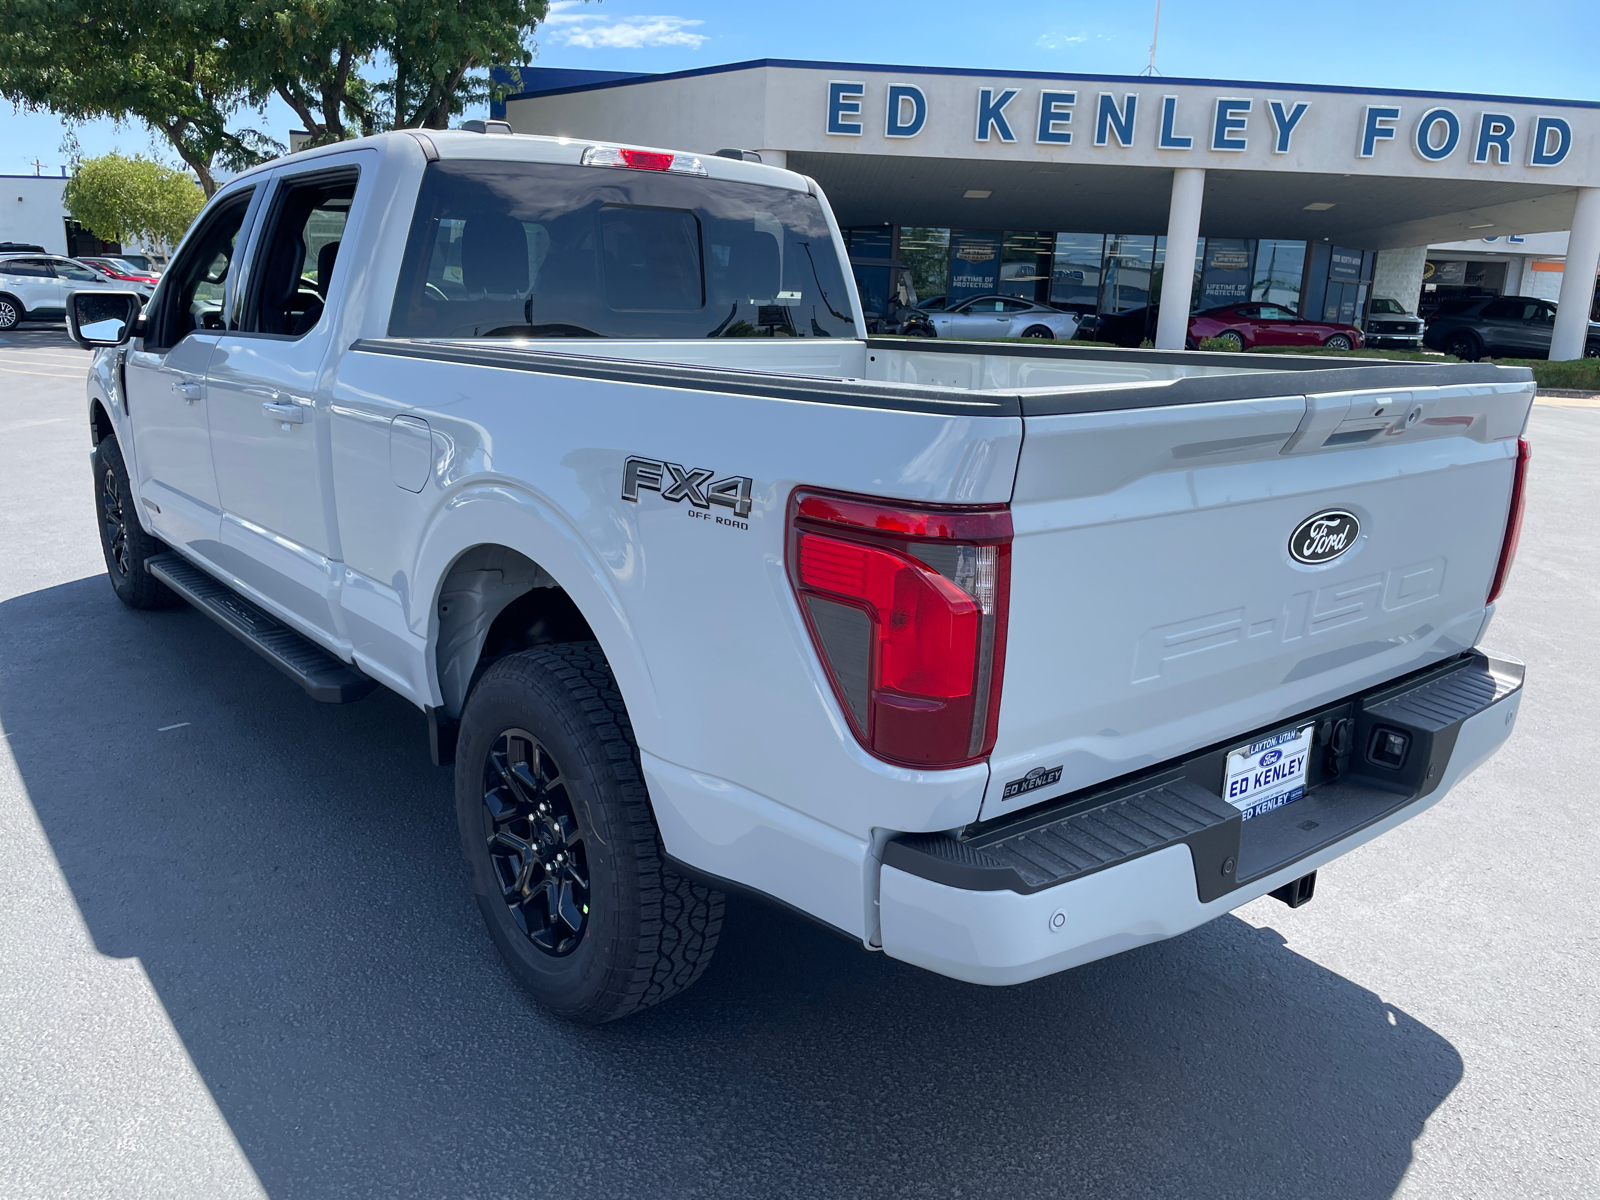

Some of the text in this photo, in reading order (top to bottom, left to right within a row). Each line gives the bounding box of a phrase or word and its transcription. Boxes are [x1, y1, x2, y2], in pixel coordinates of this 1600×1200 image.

[826, 80, 1572, 168] ED KENLEY FORD
[952, 281, 994, 289] PROTECTION
[953, 275, 983, 283] LIFETIME
[1206, 283, 1236, 291] LIFETIME
[1205, 289, 1246, 297] PROTECTION
[621, 455, 753, 519] FX4
[688, 509, 749, 531] OFF ROAD
[1303, 518, 1350, 555] Ford
[1132, 555, 1447, 684] F-150
[1279, 730, 1297, 743] UTAH
[1004, 784, 1019, 797] ED
[1020, 770, 1062, 792] KENLEY
[1229, 755, 1304, 798] ED KENLEY
[1242, 808, 1254, 822] ED
[1255, 792, 1290, 817] KENLEY
